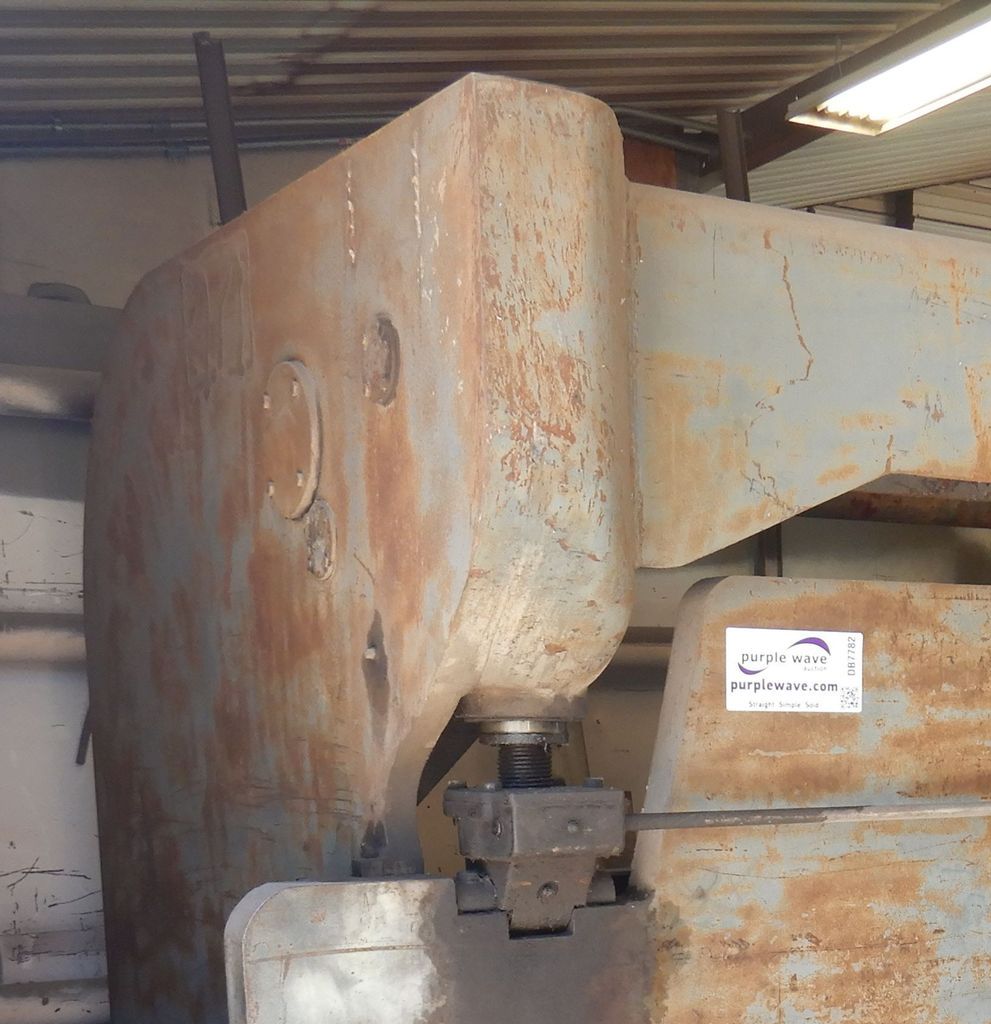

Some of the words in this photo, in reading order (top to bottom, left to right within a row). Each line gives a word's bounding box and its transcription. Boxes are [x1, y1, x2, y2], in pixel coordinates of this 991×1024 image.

[741, 651, 787, 665] purple
[792, 655, 828, 665] wave
[730, 678, 838, 693] purplewave.com
[748, 701, 775, 709] Straight
[779, 701, 801, 709] Simple
